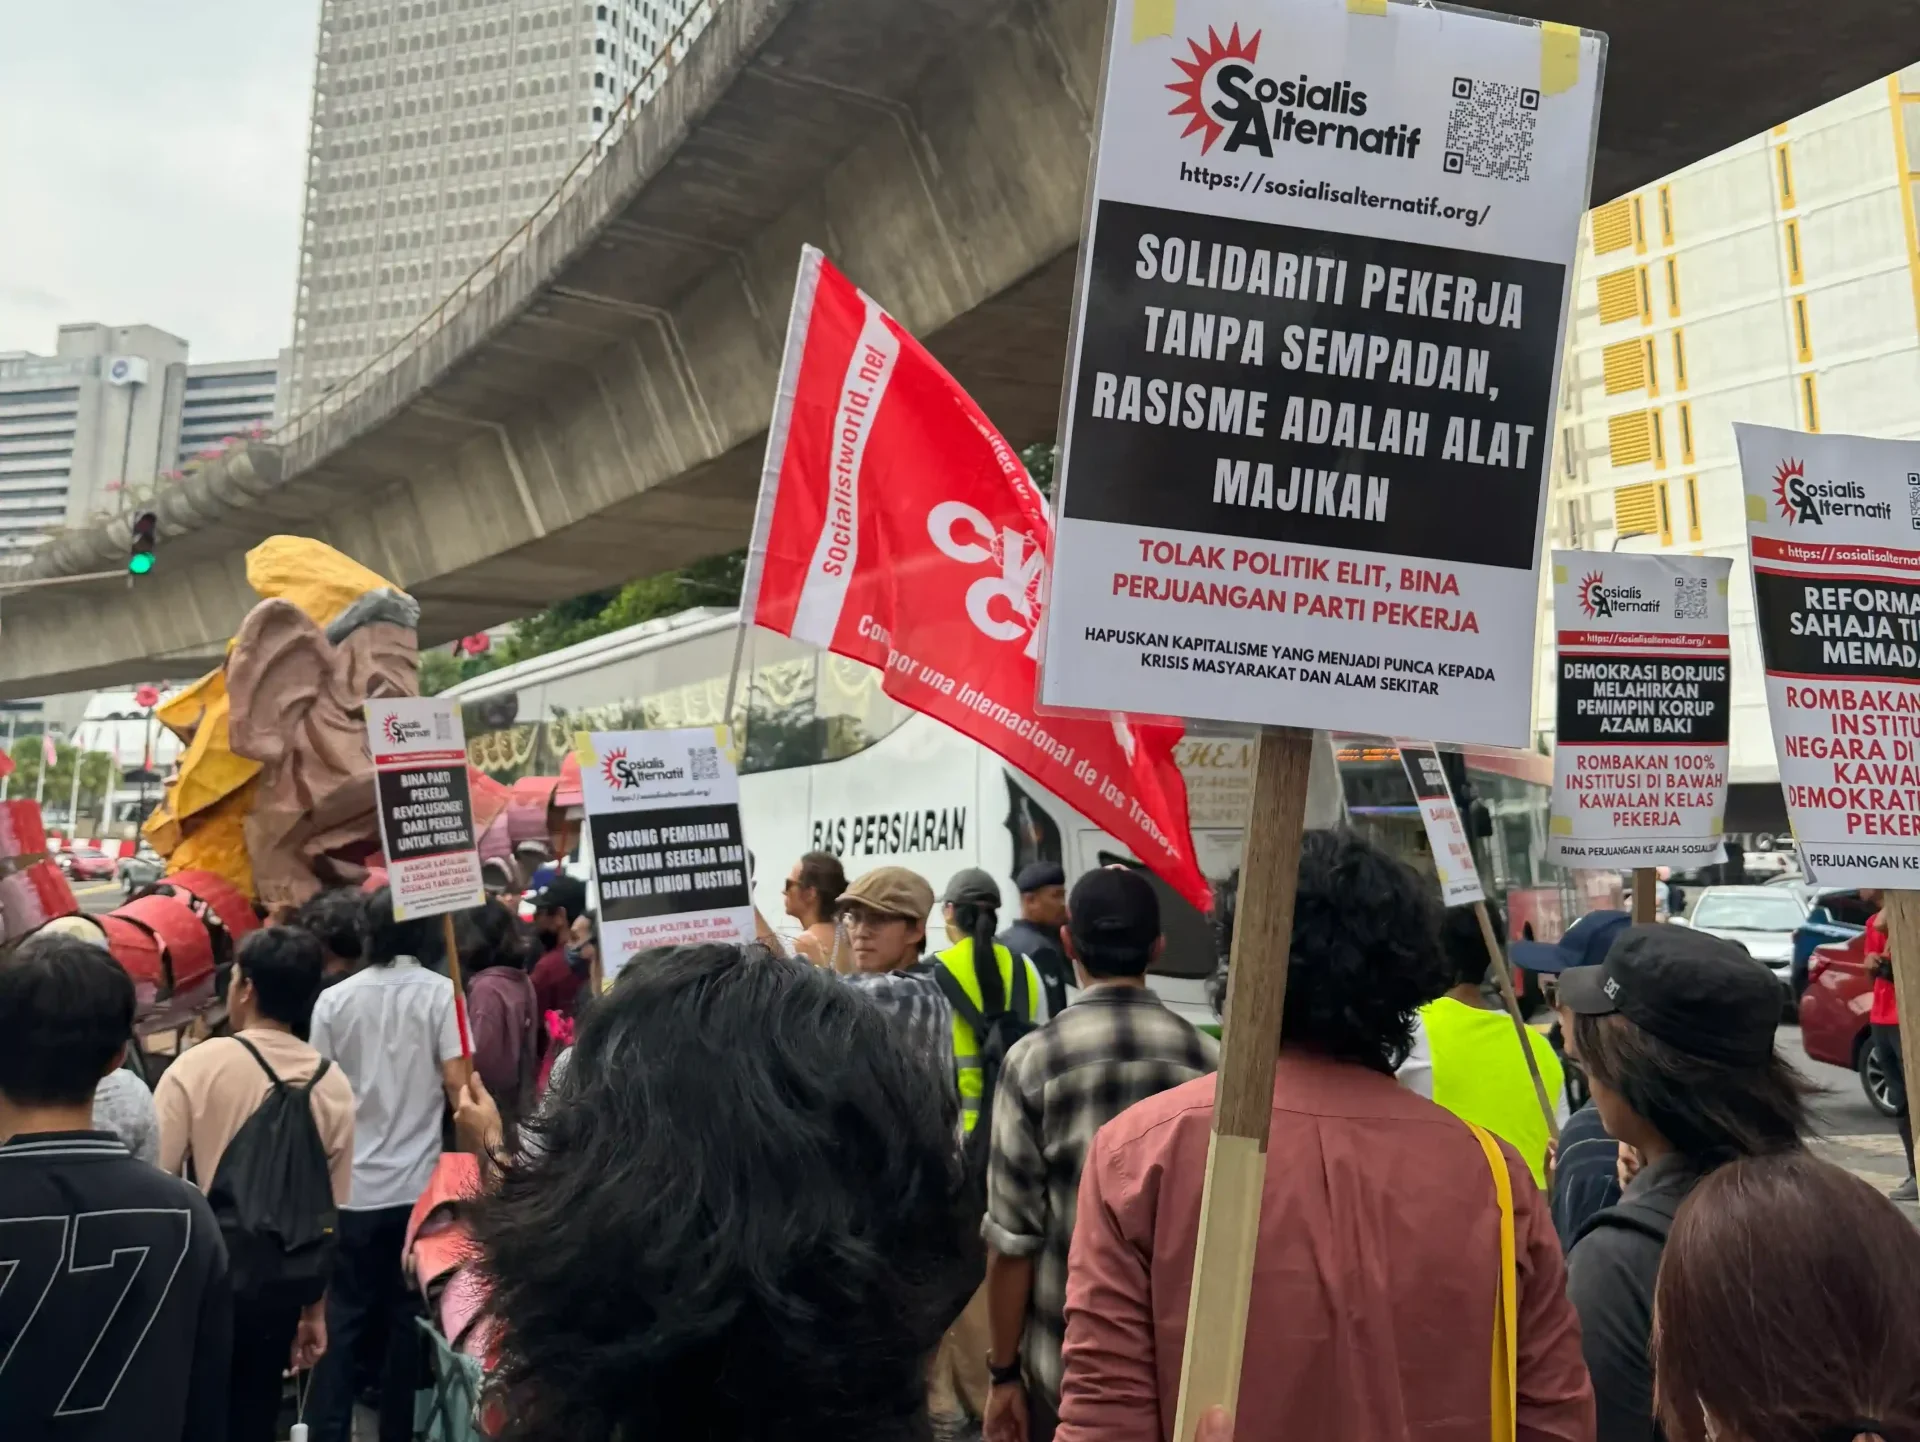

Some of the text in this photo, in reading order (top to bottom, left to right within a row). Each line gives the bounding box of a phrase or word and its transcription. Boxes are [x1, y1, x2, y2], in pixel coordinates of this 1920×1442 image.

[1211, 64, 1368, 122] Sosialis
[1223, 101, 1422, 159] Alternatif
[1179, 161, 1491, 227] https://sosialisalternatif.org/
[1136, 233, 1523, 330] SOLIDARITI PEKERJA
[1143, 306, 1500, 401] TANPA SEMPADAN,
[1091, 371, 1535, 470] RASISME ADALAH ALAT
[823, 343, 887, 577] socialistworld.net
[1212, 458, 1390, 523] MAJIKAN
[1789, 477, 1865, 508] Sosialis
[1798, 496, 1892, 526] Alternatif
[1139, 539, 1460, 596] TOLAK POLITIK ELIT, BINA
[1112, 573, 1479, 634] PERJUANGAN PARTI PEKERJA
[1591, 584, 1642, 606] Sosialis
[1596, 598, 1661, 618] Alternatif
[1587, 633, 1706, 647] https://sosialisalternatif.org/
[1790, 612, 1895, 640] SAHAJA
[1084, 626, 1496, 682] HAPUSKAN KAPITALISME YANG MENJADI PUNCA KEPADA
[1140, 653, 1439, 696] KRISIS MASYARAKAT DAN ALAM SEKITAR
[1564, 663, 1726, 682] DEMOKRASI BORJUIS
[1593, 682, 1699, 699] MELAHIRKAN
[1577, 699, 1715, 717] PEMIMPIN KORUP
[919, 666, 956, 696] una
[956, 682, 1076, 768] Internacional
[1074, 760, 1098, 786] de
[1099, 775, 1126, 808] los
[1600, 717, 1692, 734] AZAM BAKI
[1577, 754, 1715, 770] ROMBAKAN 100%
[1785, 734, 1914, 762] NEGARA DI
[400, 772, 426, 788] BINA
[616, 757, 665, 778] Sosialis
[624, 768, 684, 788] Alternatif
[1566, 772, 1723, 790] INSTITUSI DI BAWAH
[1579, 792, 1714, 809] KAWALAN KELAS
[812, 806, 967, 857] BAS PERSIARAN
[1613, 811, 1681, 827] PEKERJA
[397, 834, 432, 852] UNTUK
[607, 822, 730, 850] SOKONG PEMBINAAN
[598, 845, 743, 875] KESATUAN SEKERJA DAN
[1561, 846, 1586, 856] BINA
[1588, 845, 1641, 856] PERJUANGAN
[1643, 845, 1653, 855] KE
[1655, 845, 1679, 854] ARAH
[1810, 854, 1919, 869] PERJUANGAN KE
[601, 869, 742, 900] BANTAH UNION BUSTING
